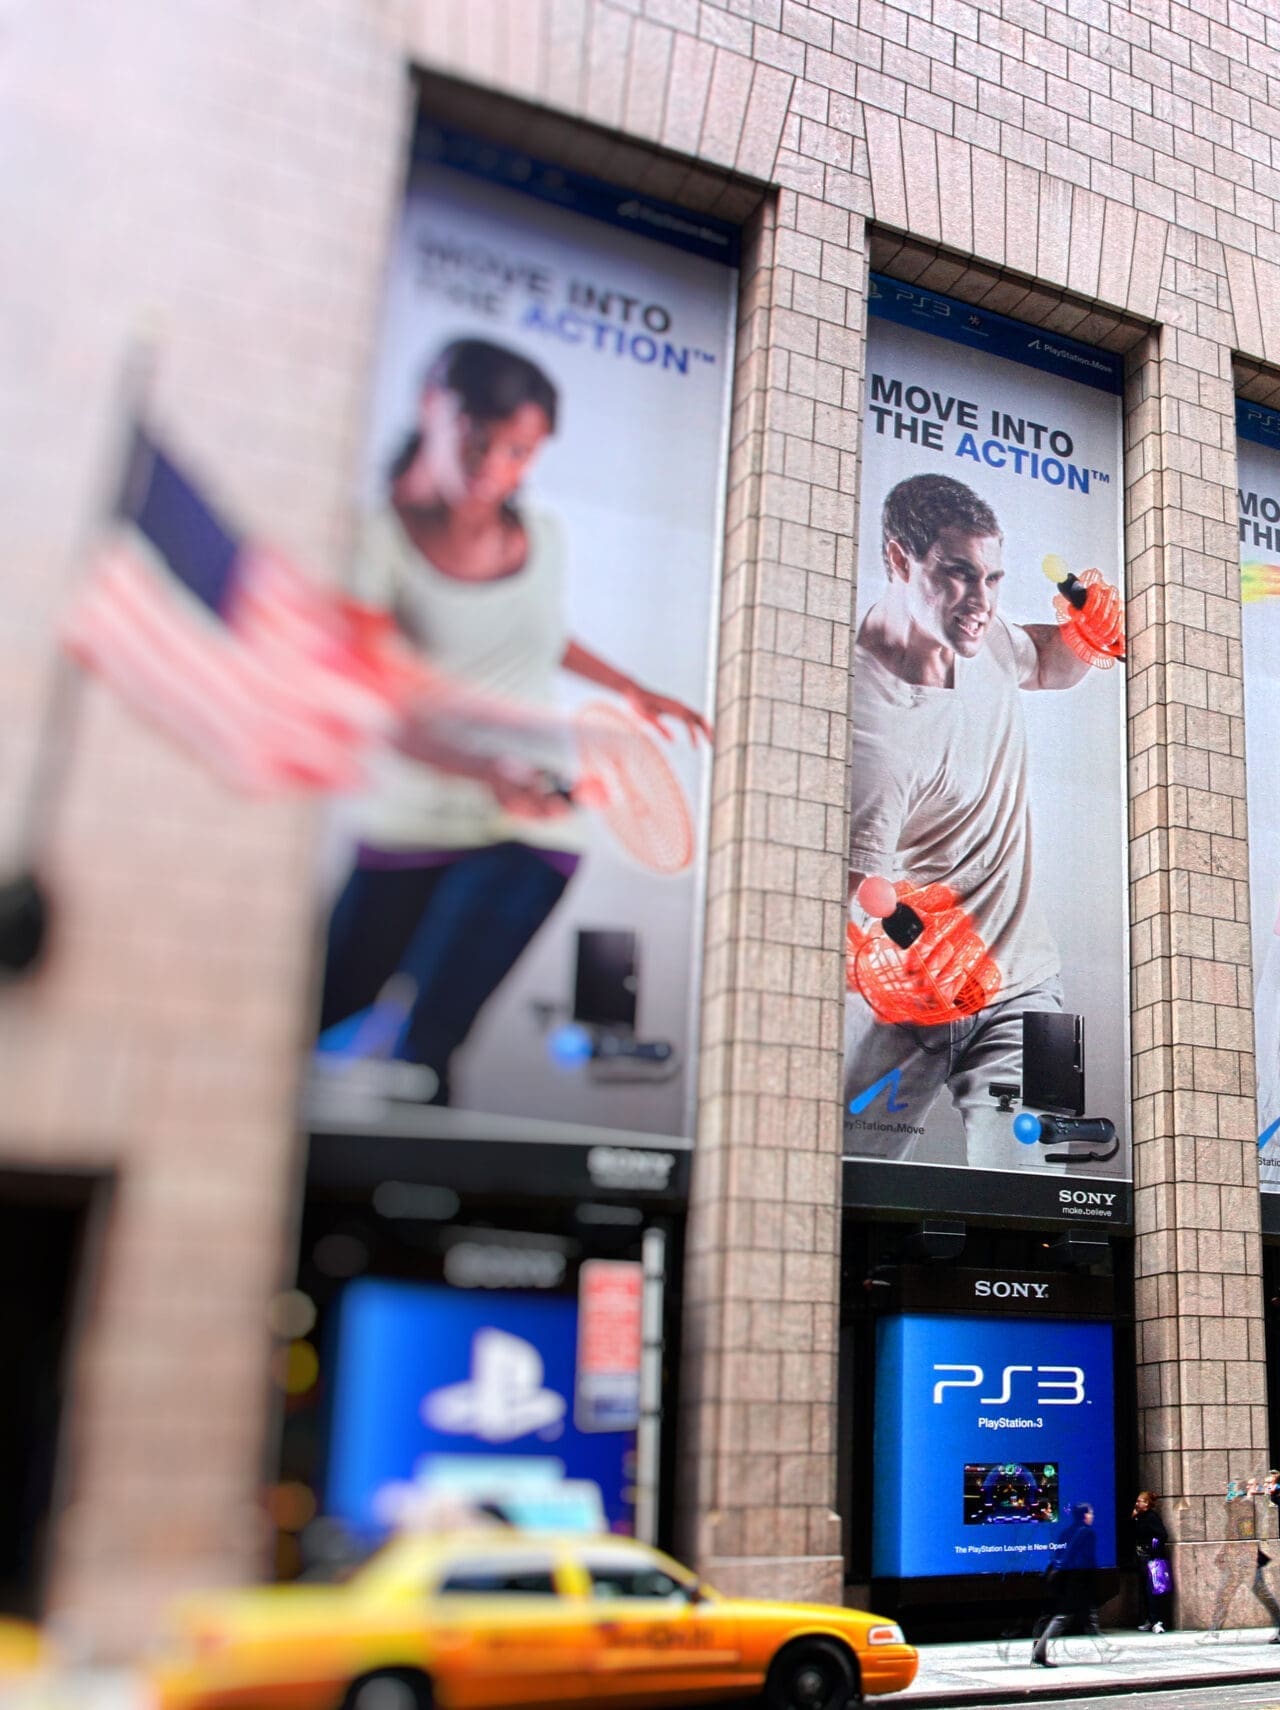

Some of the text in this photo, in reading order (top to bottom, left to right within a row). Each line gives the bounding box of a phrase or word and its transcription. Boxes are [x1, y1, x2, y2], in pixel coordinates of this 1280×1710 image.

[569, 279, 673, 333] INTO
[896, 288, 951, 316] PS3
[869, 404, 943, 451] THE
[871, 373, 1074, 458] MOVE INTO
[1059, 1189, 1116, 1206] SONY
[975, 1280, 1049, 1298] SONY
[933, 1364, 1085, 1405] PS3
[955, 1546, 967, 1554] The
[968, 1545, 1003, 1554] PlayStation
[1004, 1543, 1026, 1552] Lounge
